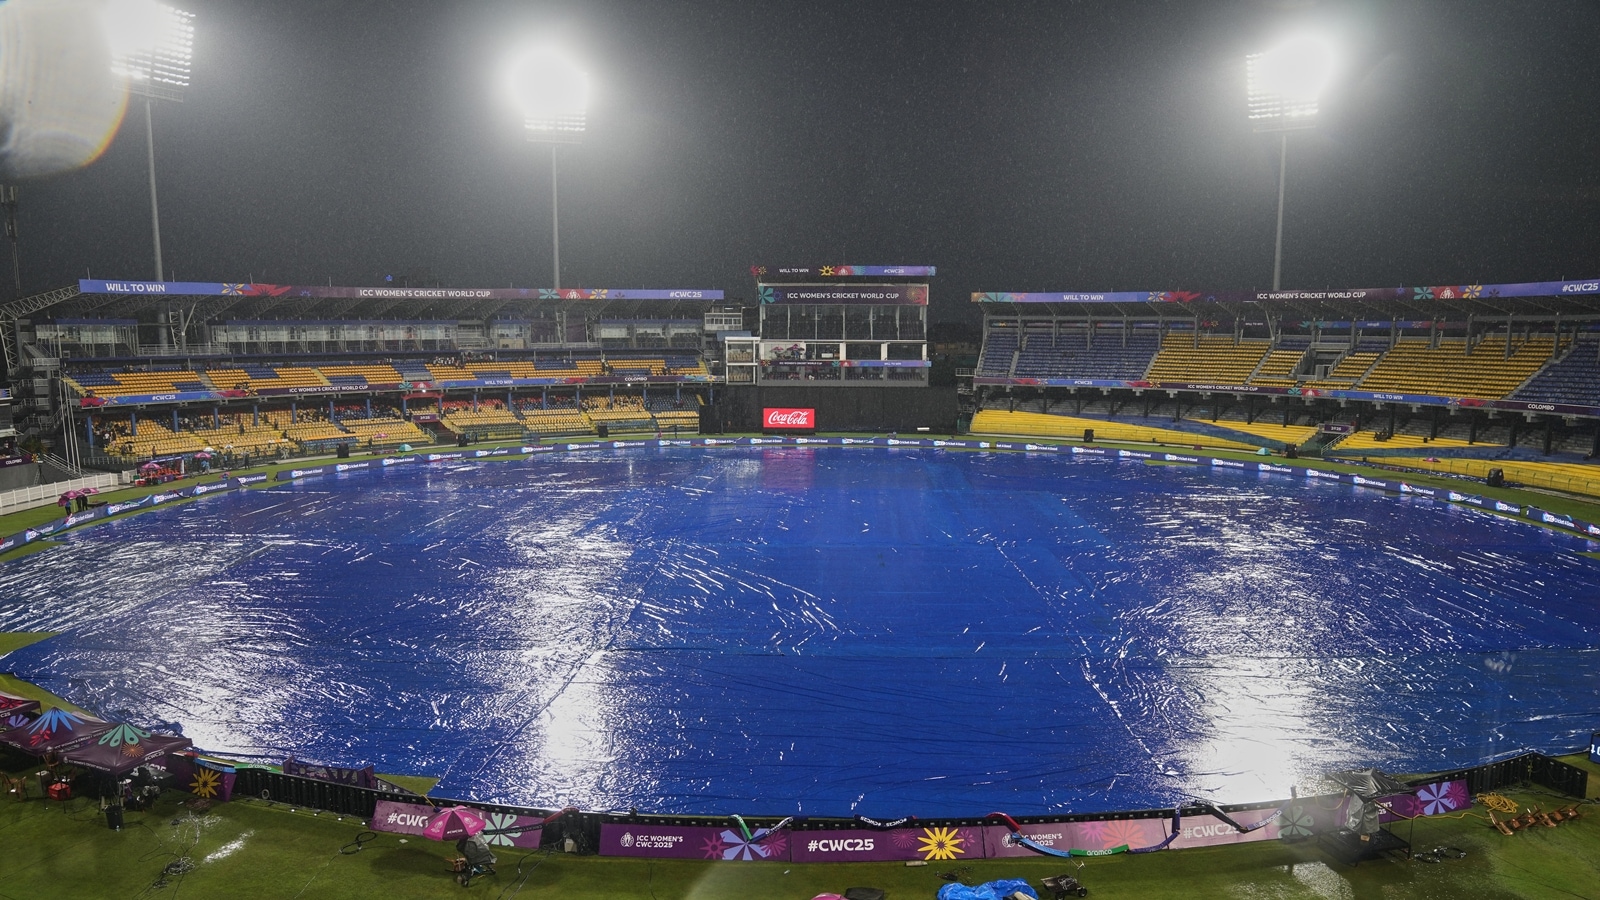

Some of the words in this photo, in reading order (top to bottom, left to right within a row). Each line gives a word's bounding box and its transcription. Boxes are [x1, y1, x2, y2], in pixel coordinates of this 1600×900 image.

[106, 283, 130, 291] WILL
[146, 284, 165, 292] WIN
[1562, 282, 1599, 292] #CWC25
[768, 411, 808, 424] Coca-Cola
[144, 751, 165, 761] #CWC25
[387, 813, 428, 827] #CWC
[808, 839, 874, 851] #CWC25
